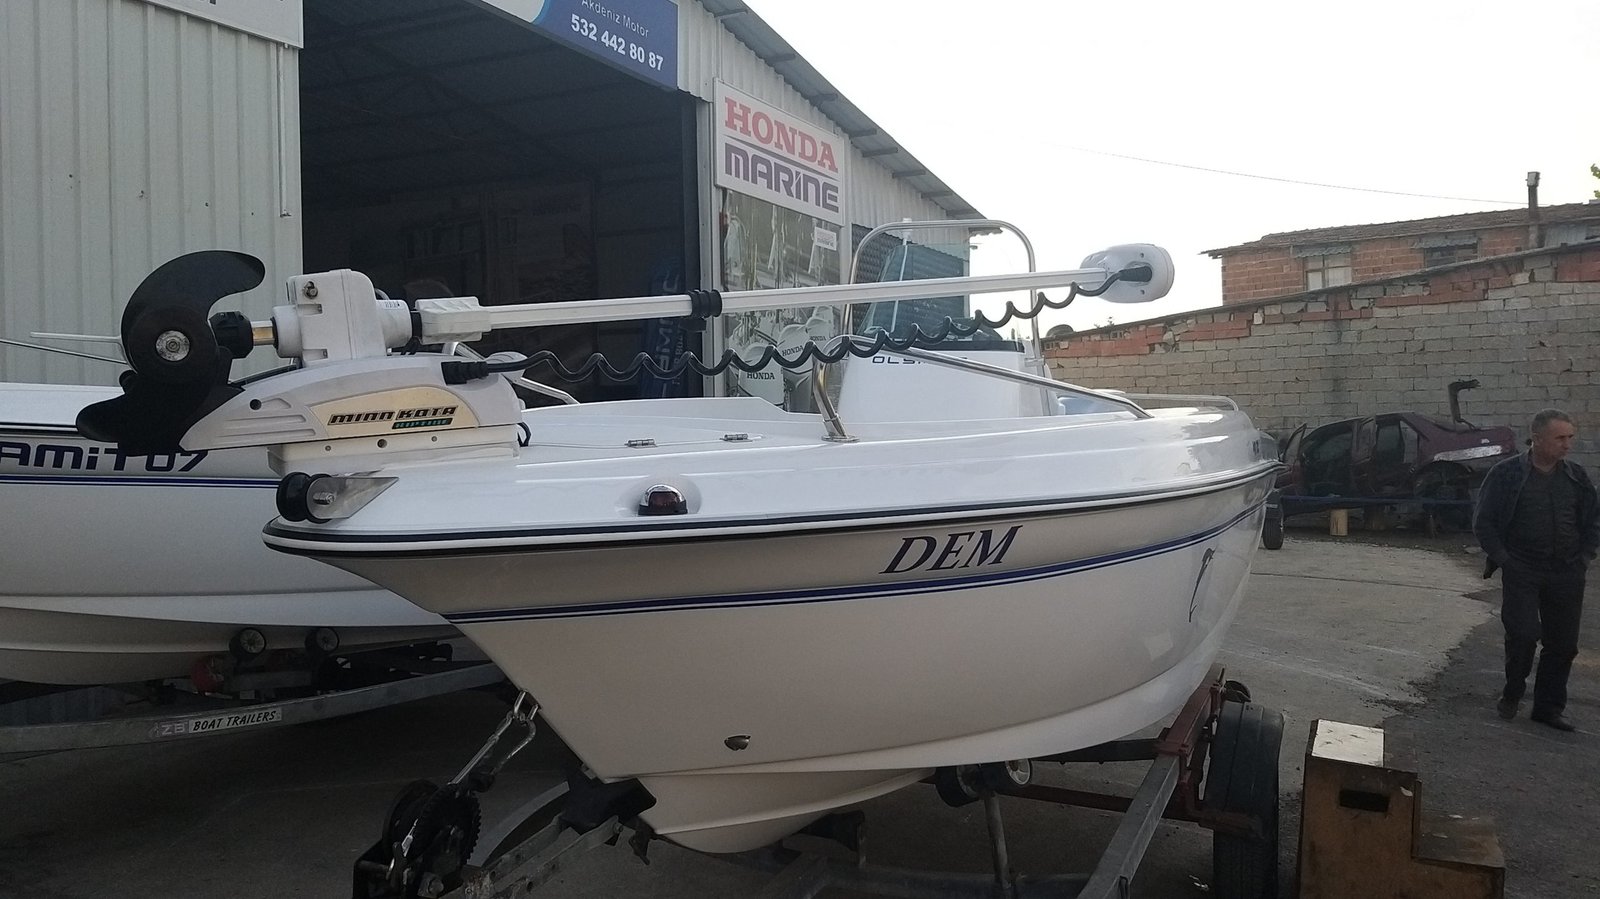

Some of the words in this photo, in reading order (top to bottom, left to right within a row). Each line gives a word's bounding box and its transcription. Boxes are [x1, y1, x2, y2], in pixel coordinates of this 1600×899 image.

[581, 0, 621, 24] Akdeniz
[622, 15, 649, 37] Motor
[571, 13, 597, 41] 532
[601, 31, 626, 55] 442
[629, 43, 645, 63] 80
[648, 52, 664, 71] 87
[724, 96, 838, 174] HONDA
[724, 142, 839, 214] MARINE
[782, 345, 804, 357] HONDA
[747, 372, 776, 380] HONDA
[328, 411, 396, 425] MINN
[396, 406, 458, 420] KOTA
[878, 524, 1024, 575] DEM
[193, 718, 223, 732] BOAT
[226, 710, 277, 727] TRAILERS
